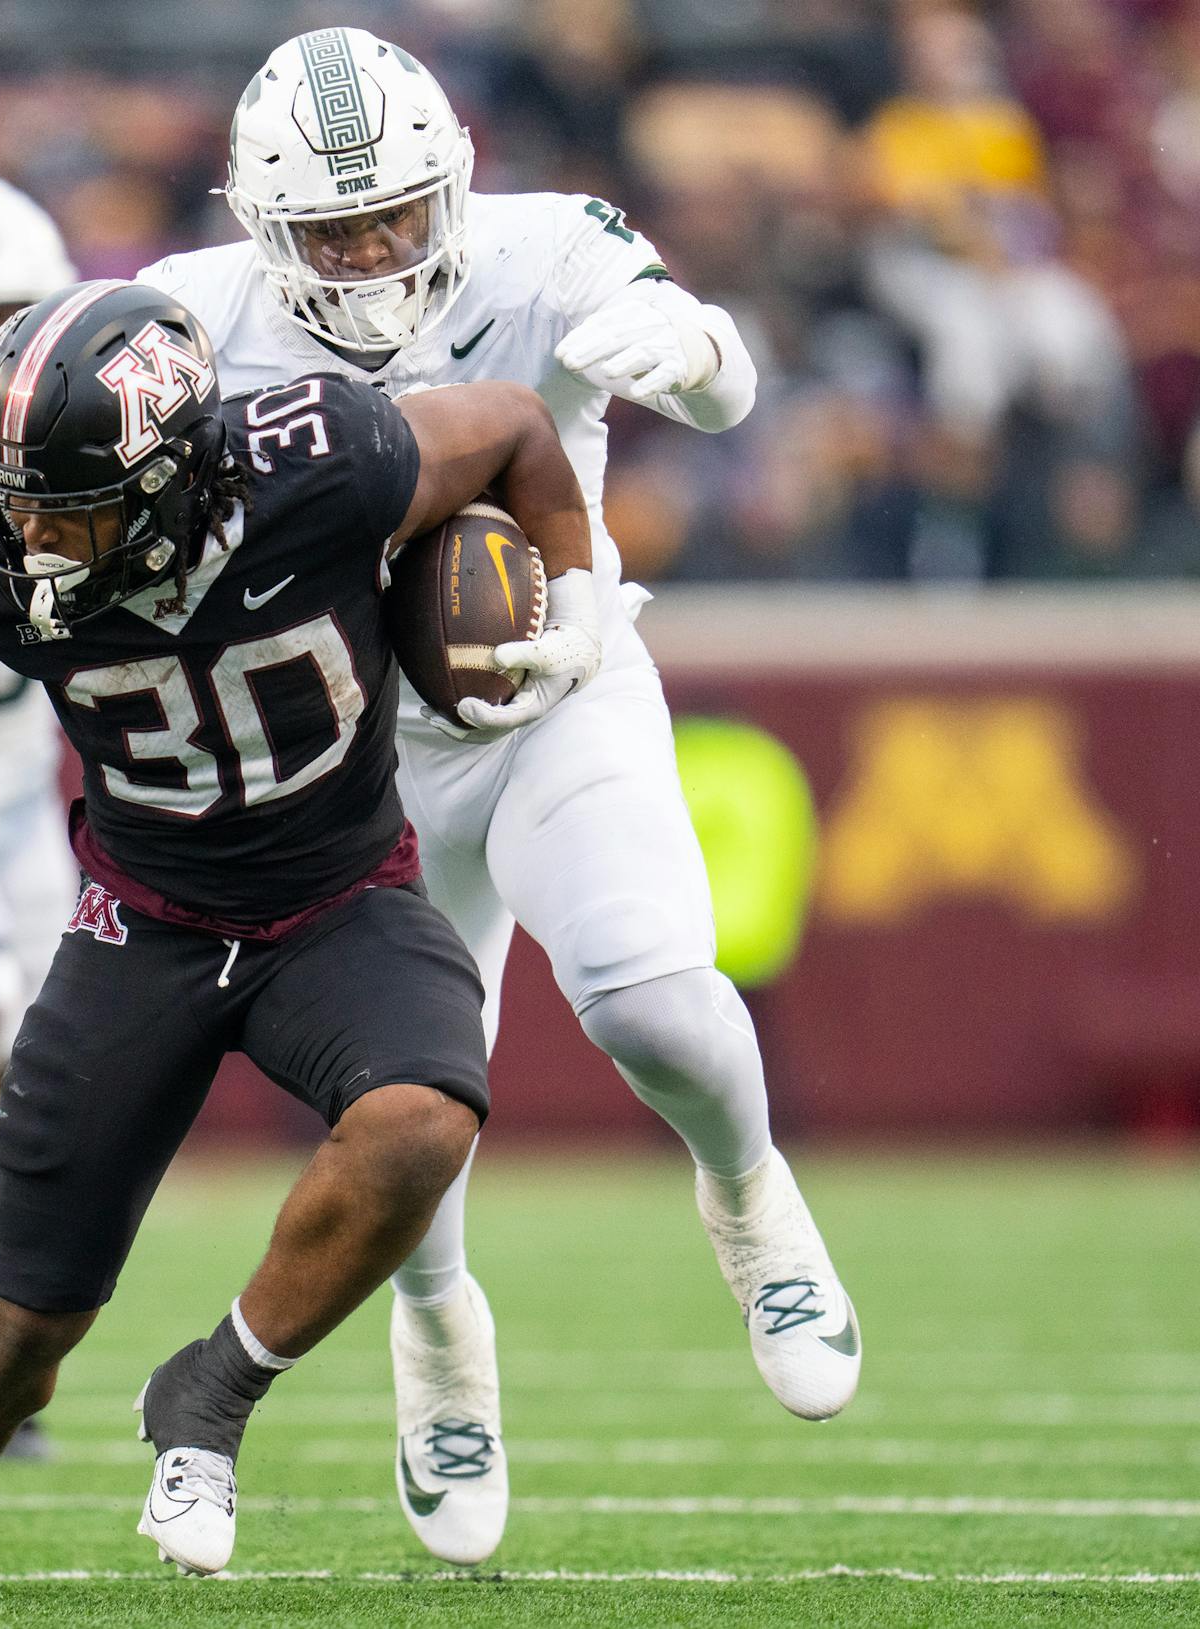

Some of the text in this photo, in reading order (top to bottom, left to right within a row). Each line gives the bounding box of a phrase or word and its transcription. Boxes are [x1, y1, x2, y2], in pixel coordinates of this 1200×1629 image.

[335, 173, 378, 195] STATE
[357, 288, 386, 299] SHOCK
[95, 320, 216, 469] M
[246, 379, 332, 476] 30
[451, 575, 462, 617] ELITE
[62, 607, 369, 820] 30
[66, 882, 129, 946] M
